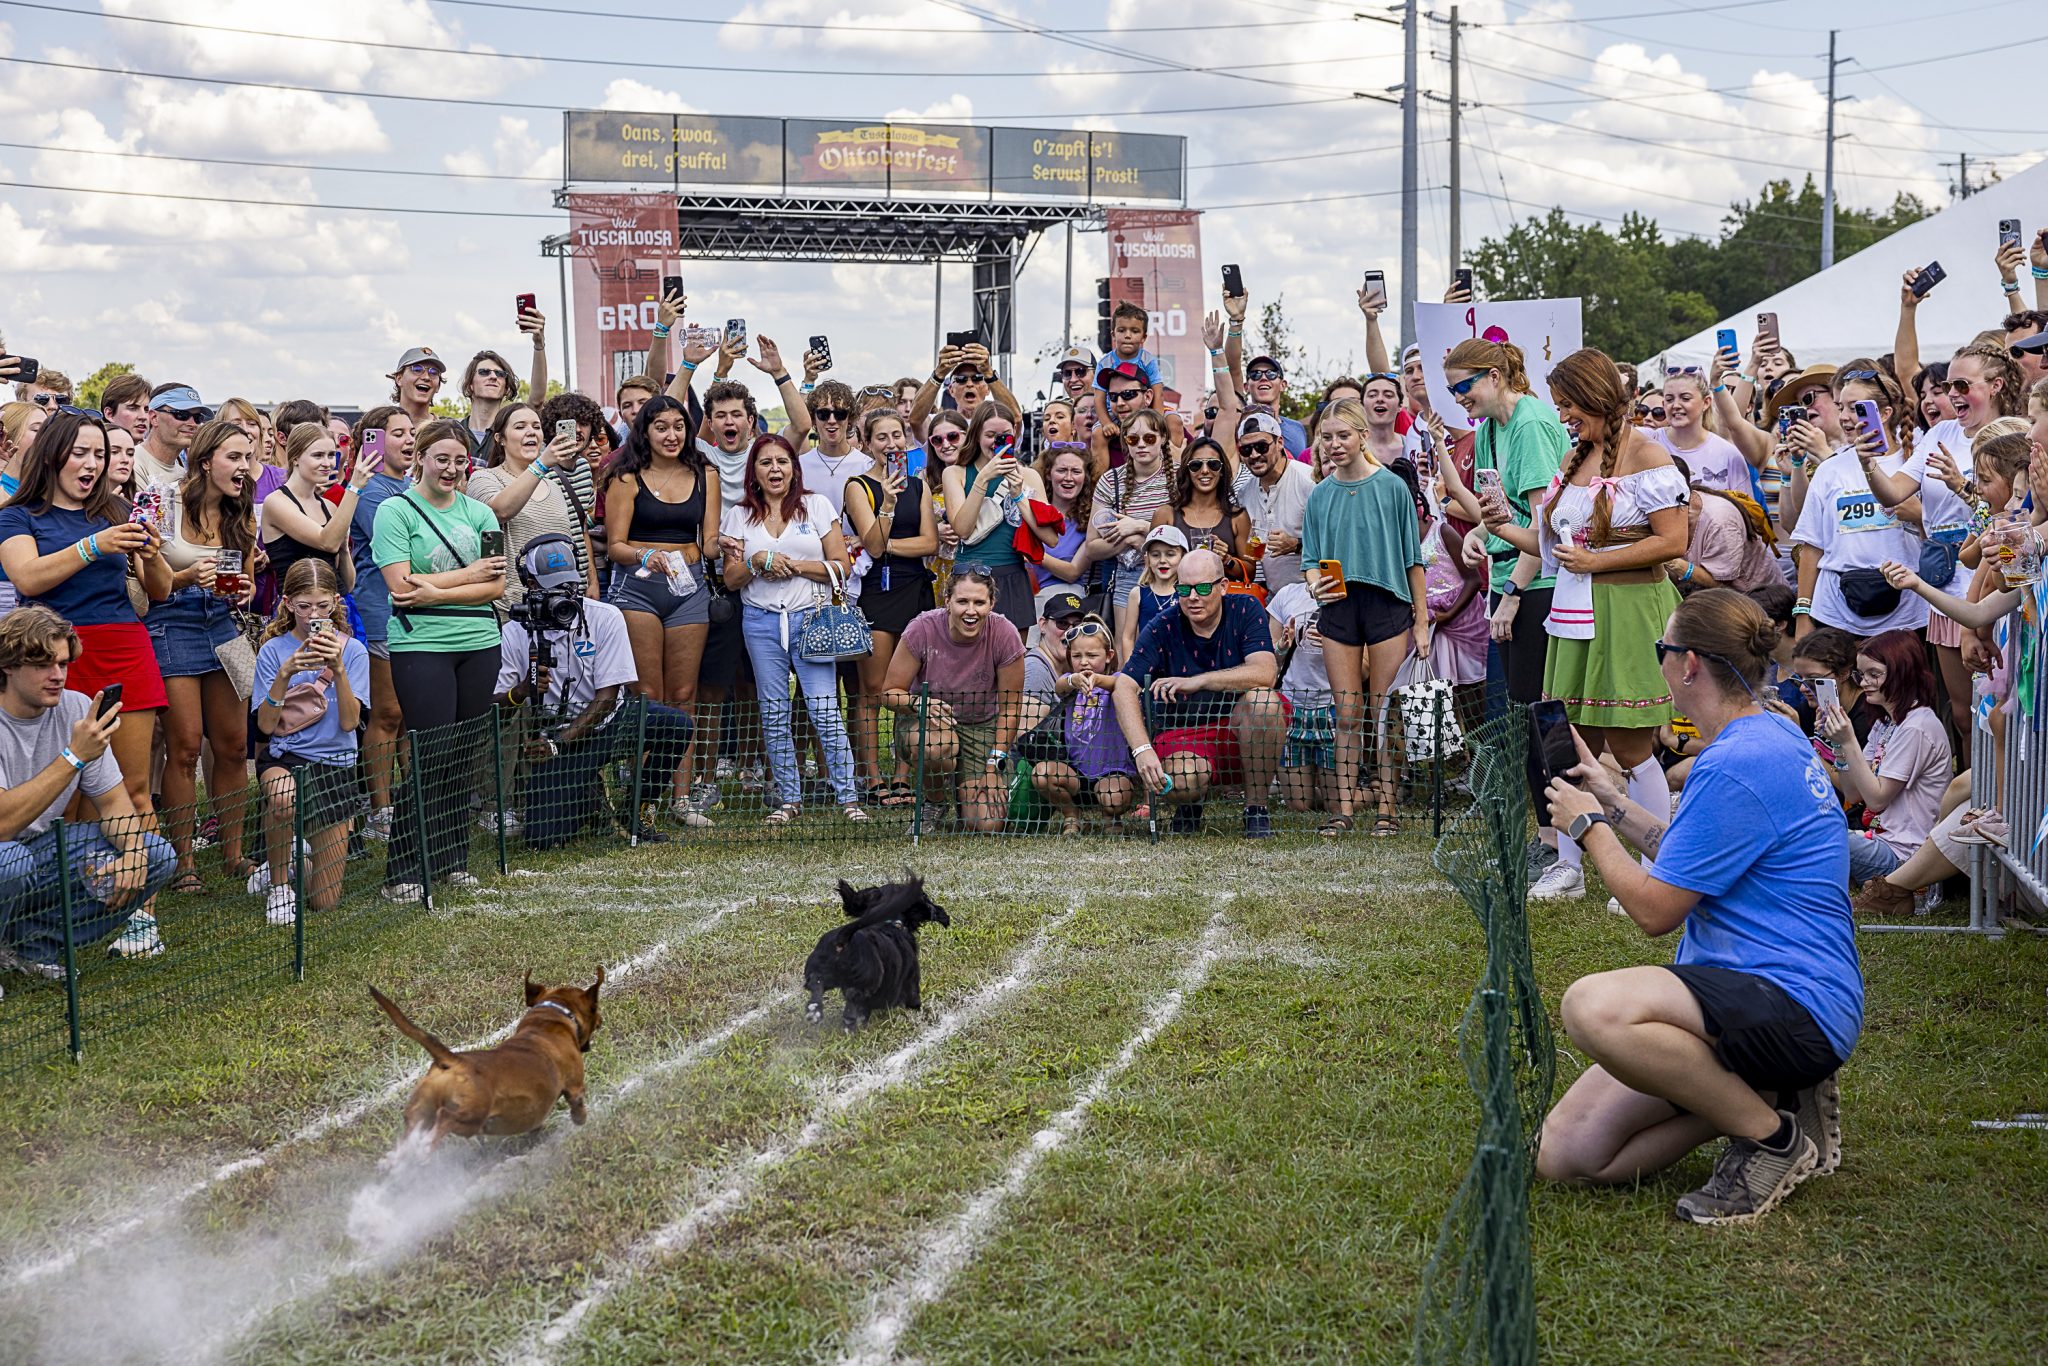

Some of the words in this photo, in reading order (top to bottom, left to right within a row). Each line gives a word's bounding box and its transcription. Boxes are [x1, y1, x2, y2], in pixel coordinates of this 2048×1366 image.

[622, 124, 666, 144] Oans,
[671, 128, 718, 145] zwoa,
[859, 129, 919, 142] Tuscaloosa
[818, 143, 957, 175] Oktoberfest
[1032, 138, 1085, 161] O'zapft
[622, 150, 659, 170] drei,
[1032, 163, 1087, 182] Servus!
[1095, 167, 1139, 184] Prost!
[611, 216, 638, 229] Visit
[578, 229, 673, 246] TUSCALOOSA
[1143, 230, 1166, 242] Visit
[1114, 242, 1196, 259] TUSCALOOSA
[1841, 502, 1875, 521] 299
